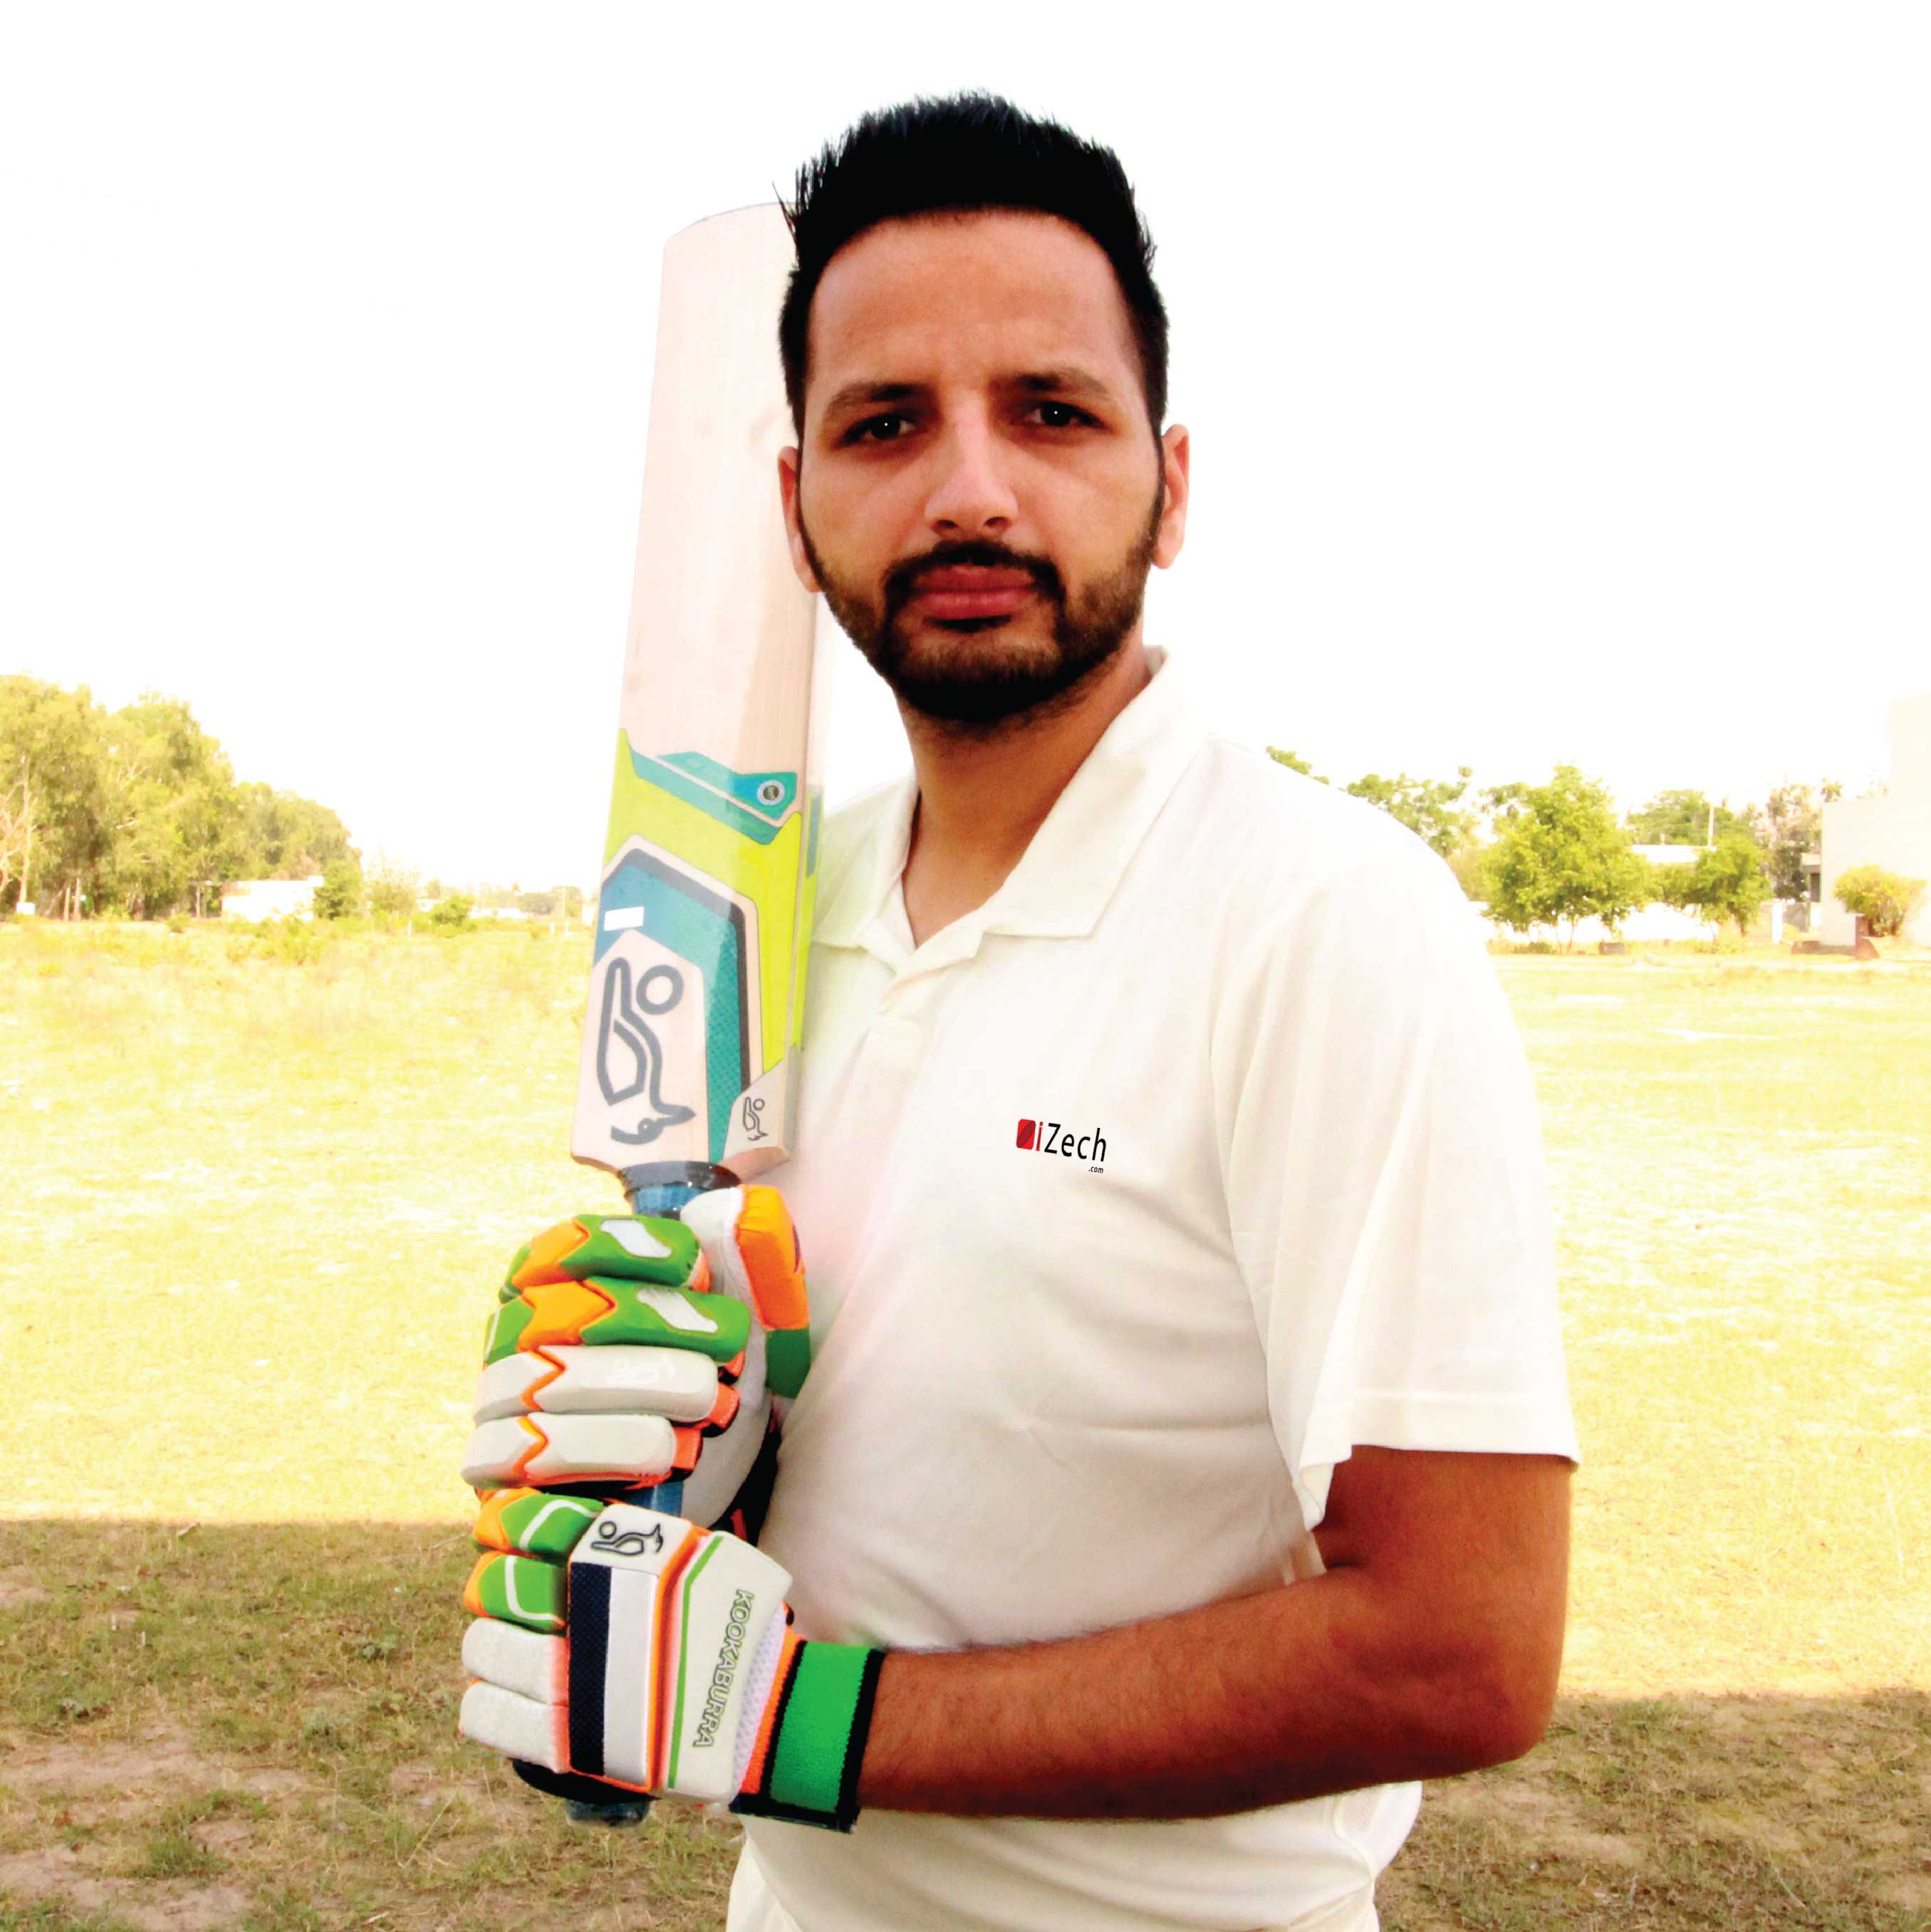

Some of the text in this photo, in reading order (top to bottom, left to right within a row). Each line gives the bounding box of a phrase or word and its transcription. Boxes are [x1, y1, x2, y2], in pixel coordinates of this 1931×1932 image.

[1036, 1122, 1107, 1162] iZech
[1088, 1166, 1104, 1174] .com
[692, 1589, 754, 1748] KOOKABURRA
